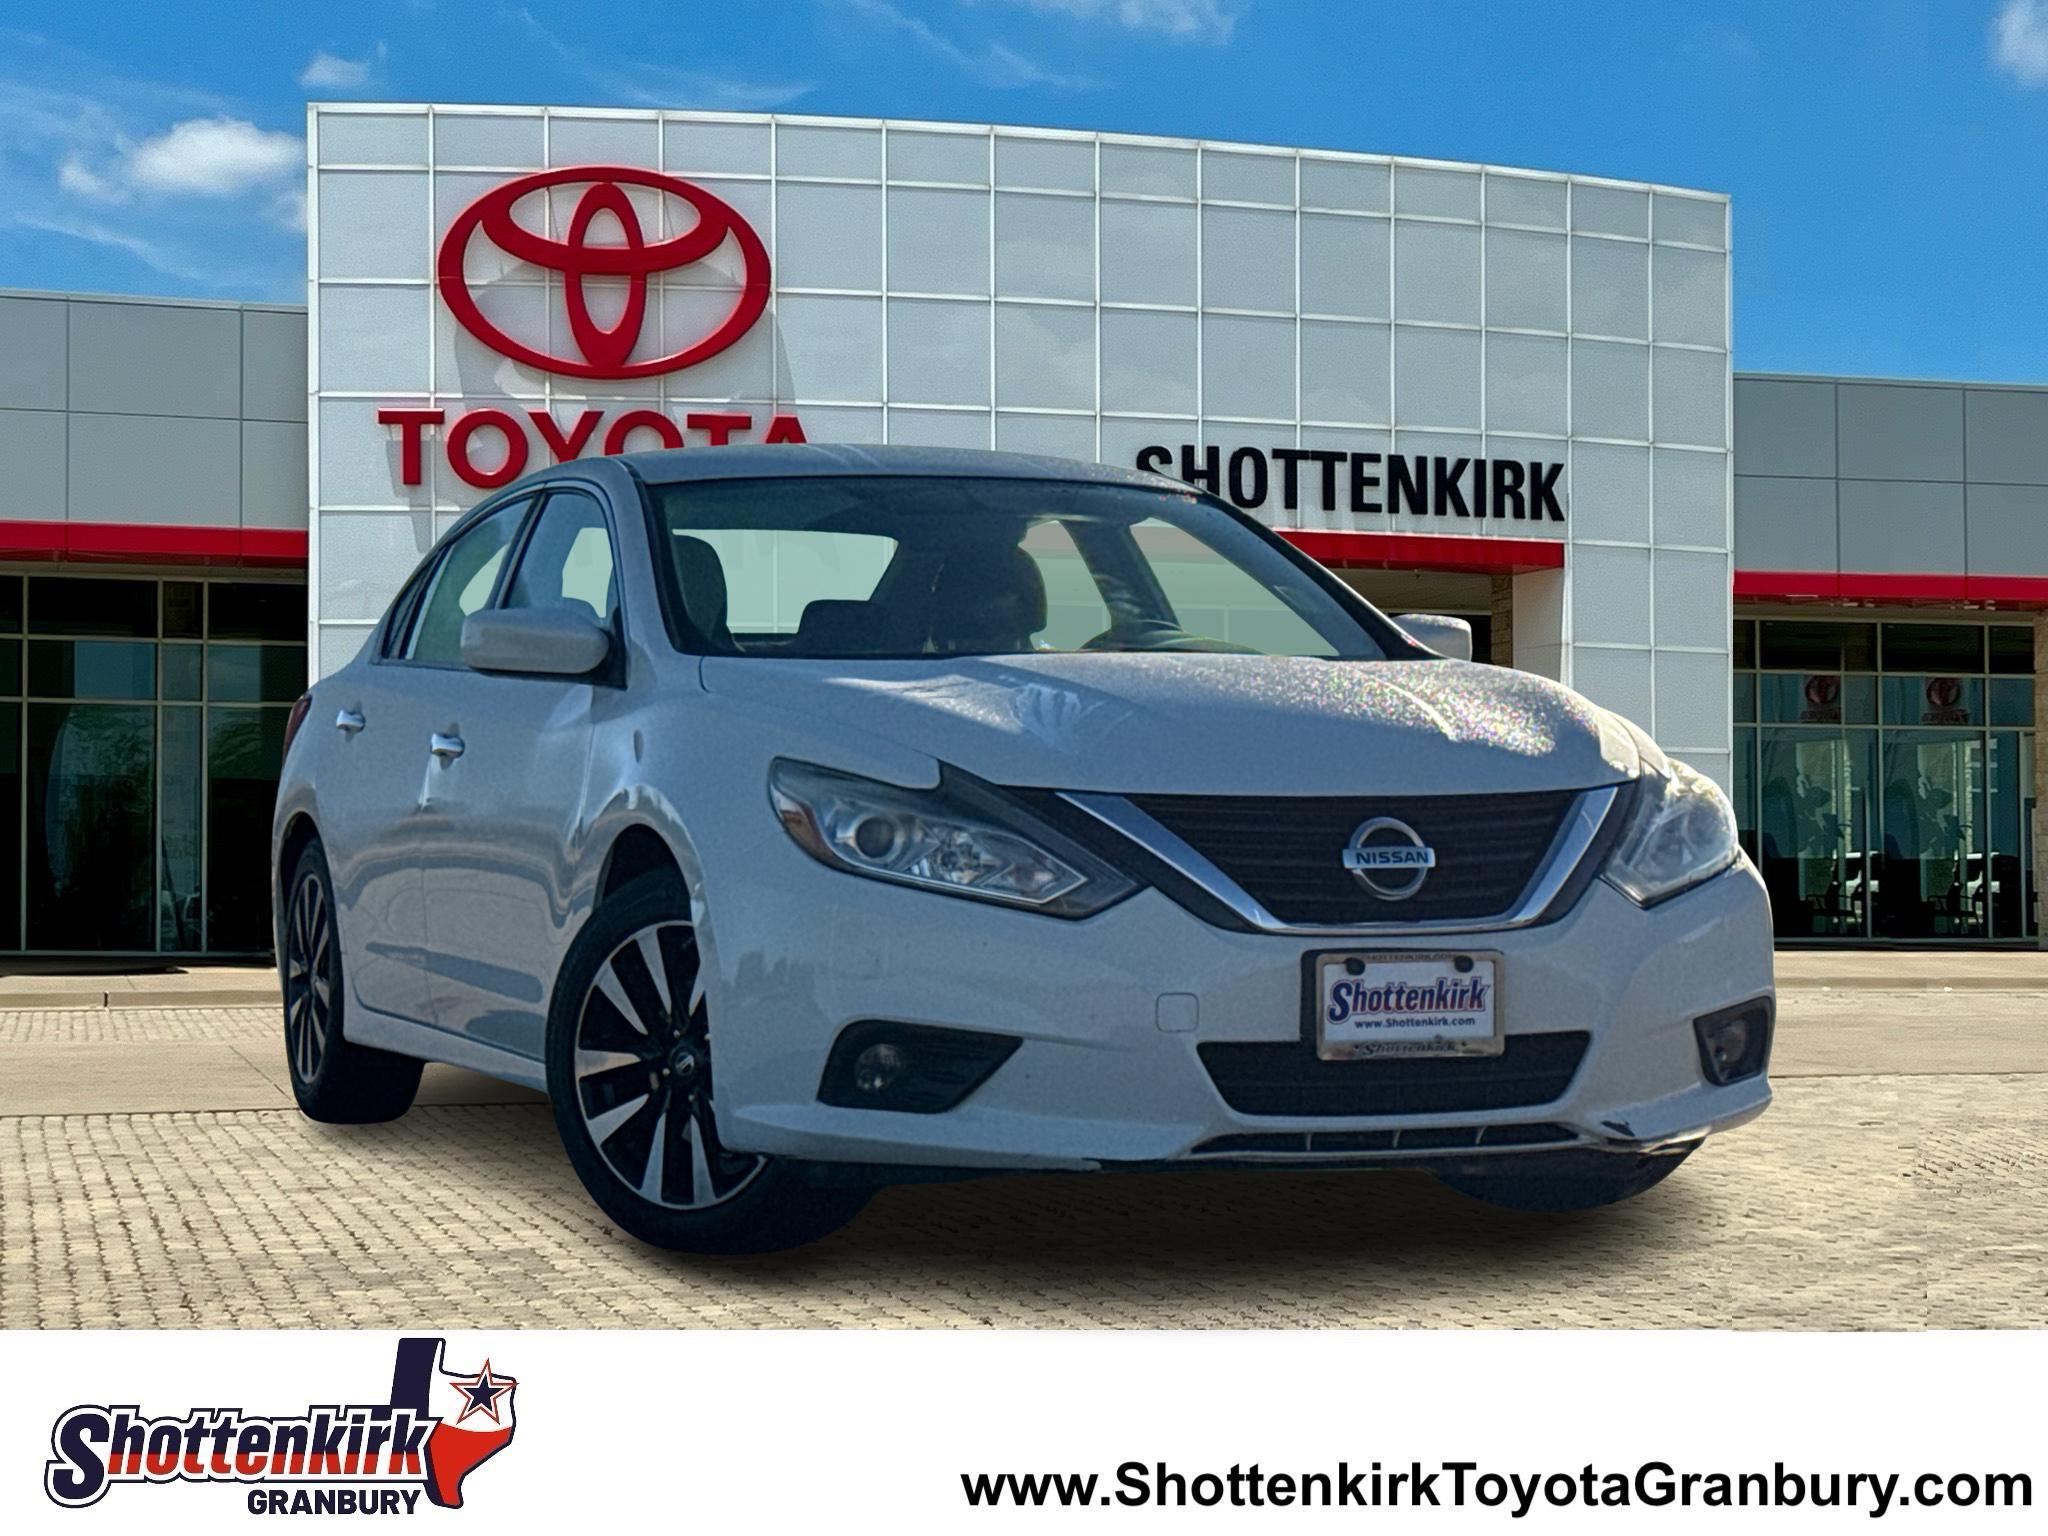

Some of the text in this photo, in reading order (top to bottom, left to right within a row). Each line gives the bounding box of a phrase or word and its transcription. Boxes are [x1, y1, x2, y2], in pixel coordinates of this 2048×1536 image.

[1355, 850, 1429, 865] NISSAN
[1328, 978, 1488, 1023] Shottenkirk
[1354, 1016, 1476, 1029] www.Shottenkirk.com
